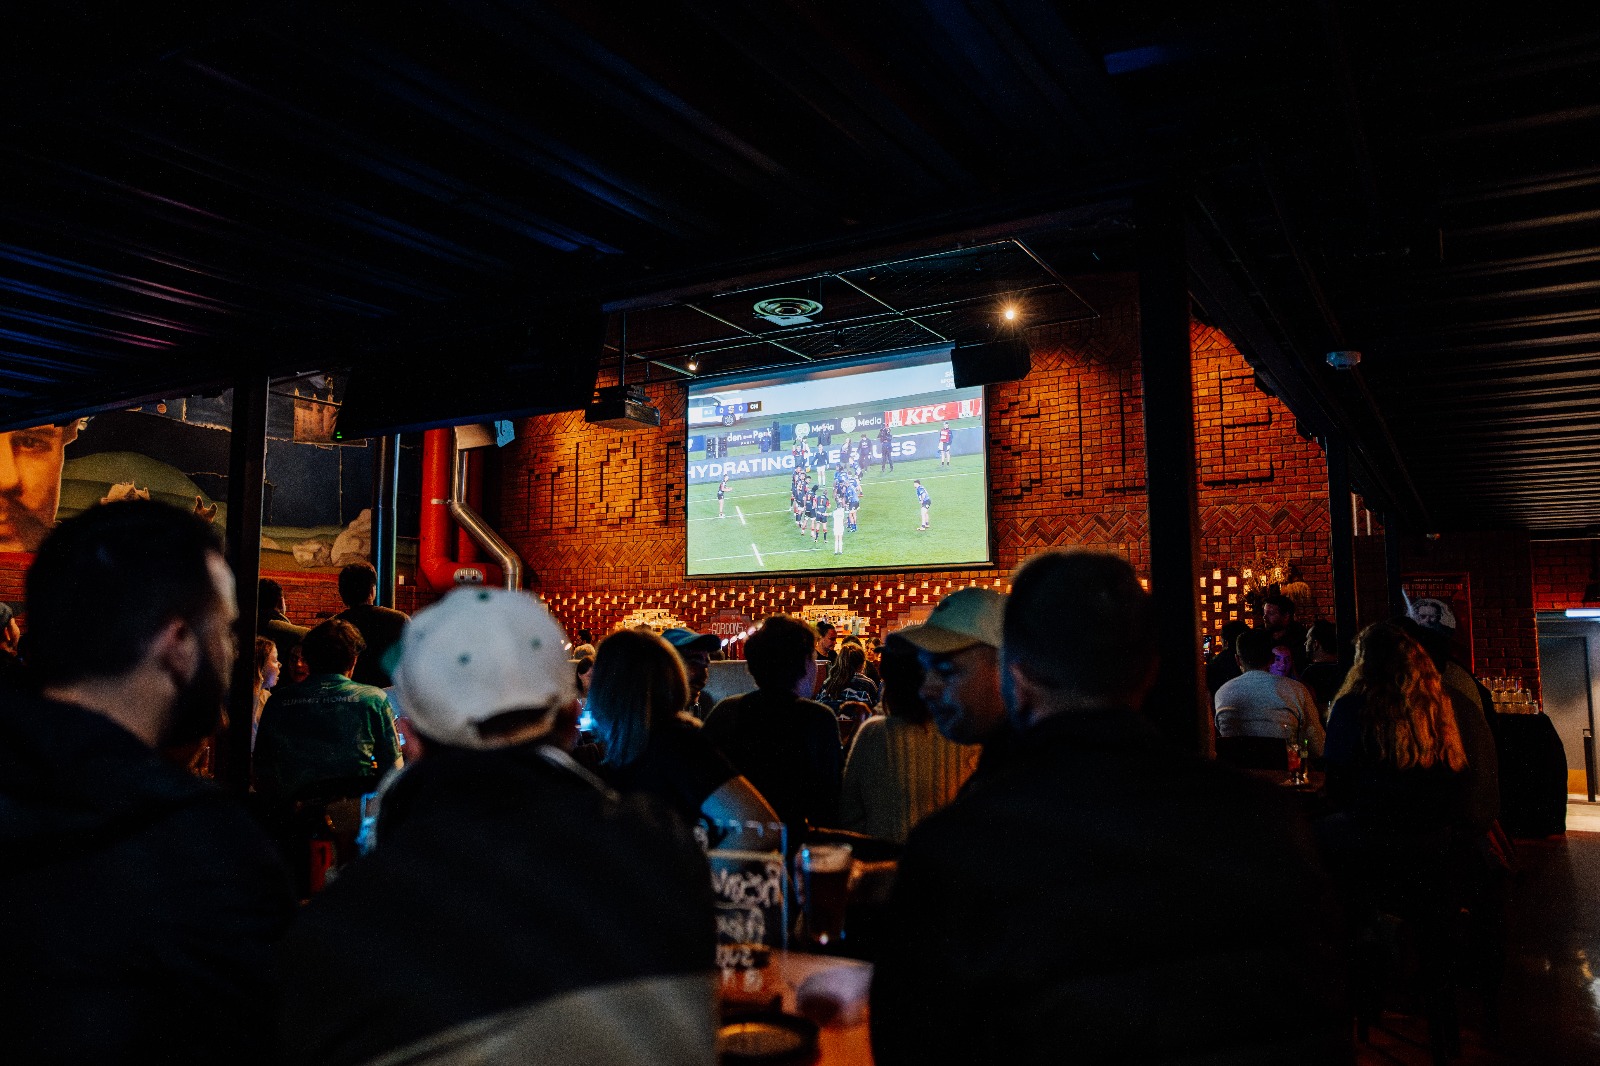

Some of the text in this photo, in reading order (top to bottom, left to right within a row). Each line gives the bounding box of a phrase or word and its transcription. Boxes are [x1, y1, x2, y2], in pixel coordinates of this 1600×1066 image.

[857, 416, 882, 427] Media
[905, 405, 946, 425] KFC
[688, 456, 796, 479] HYDRATING
